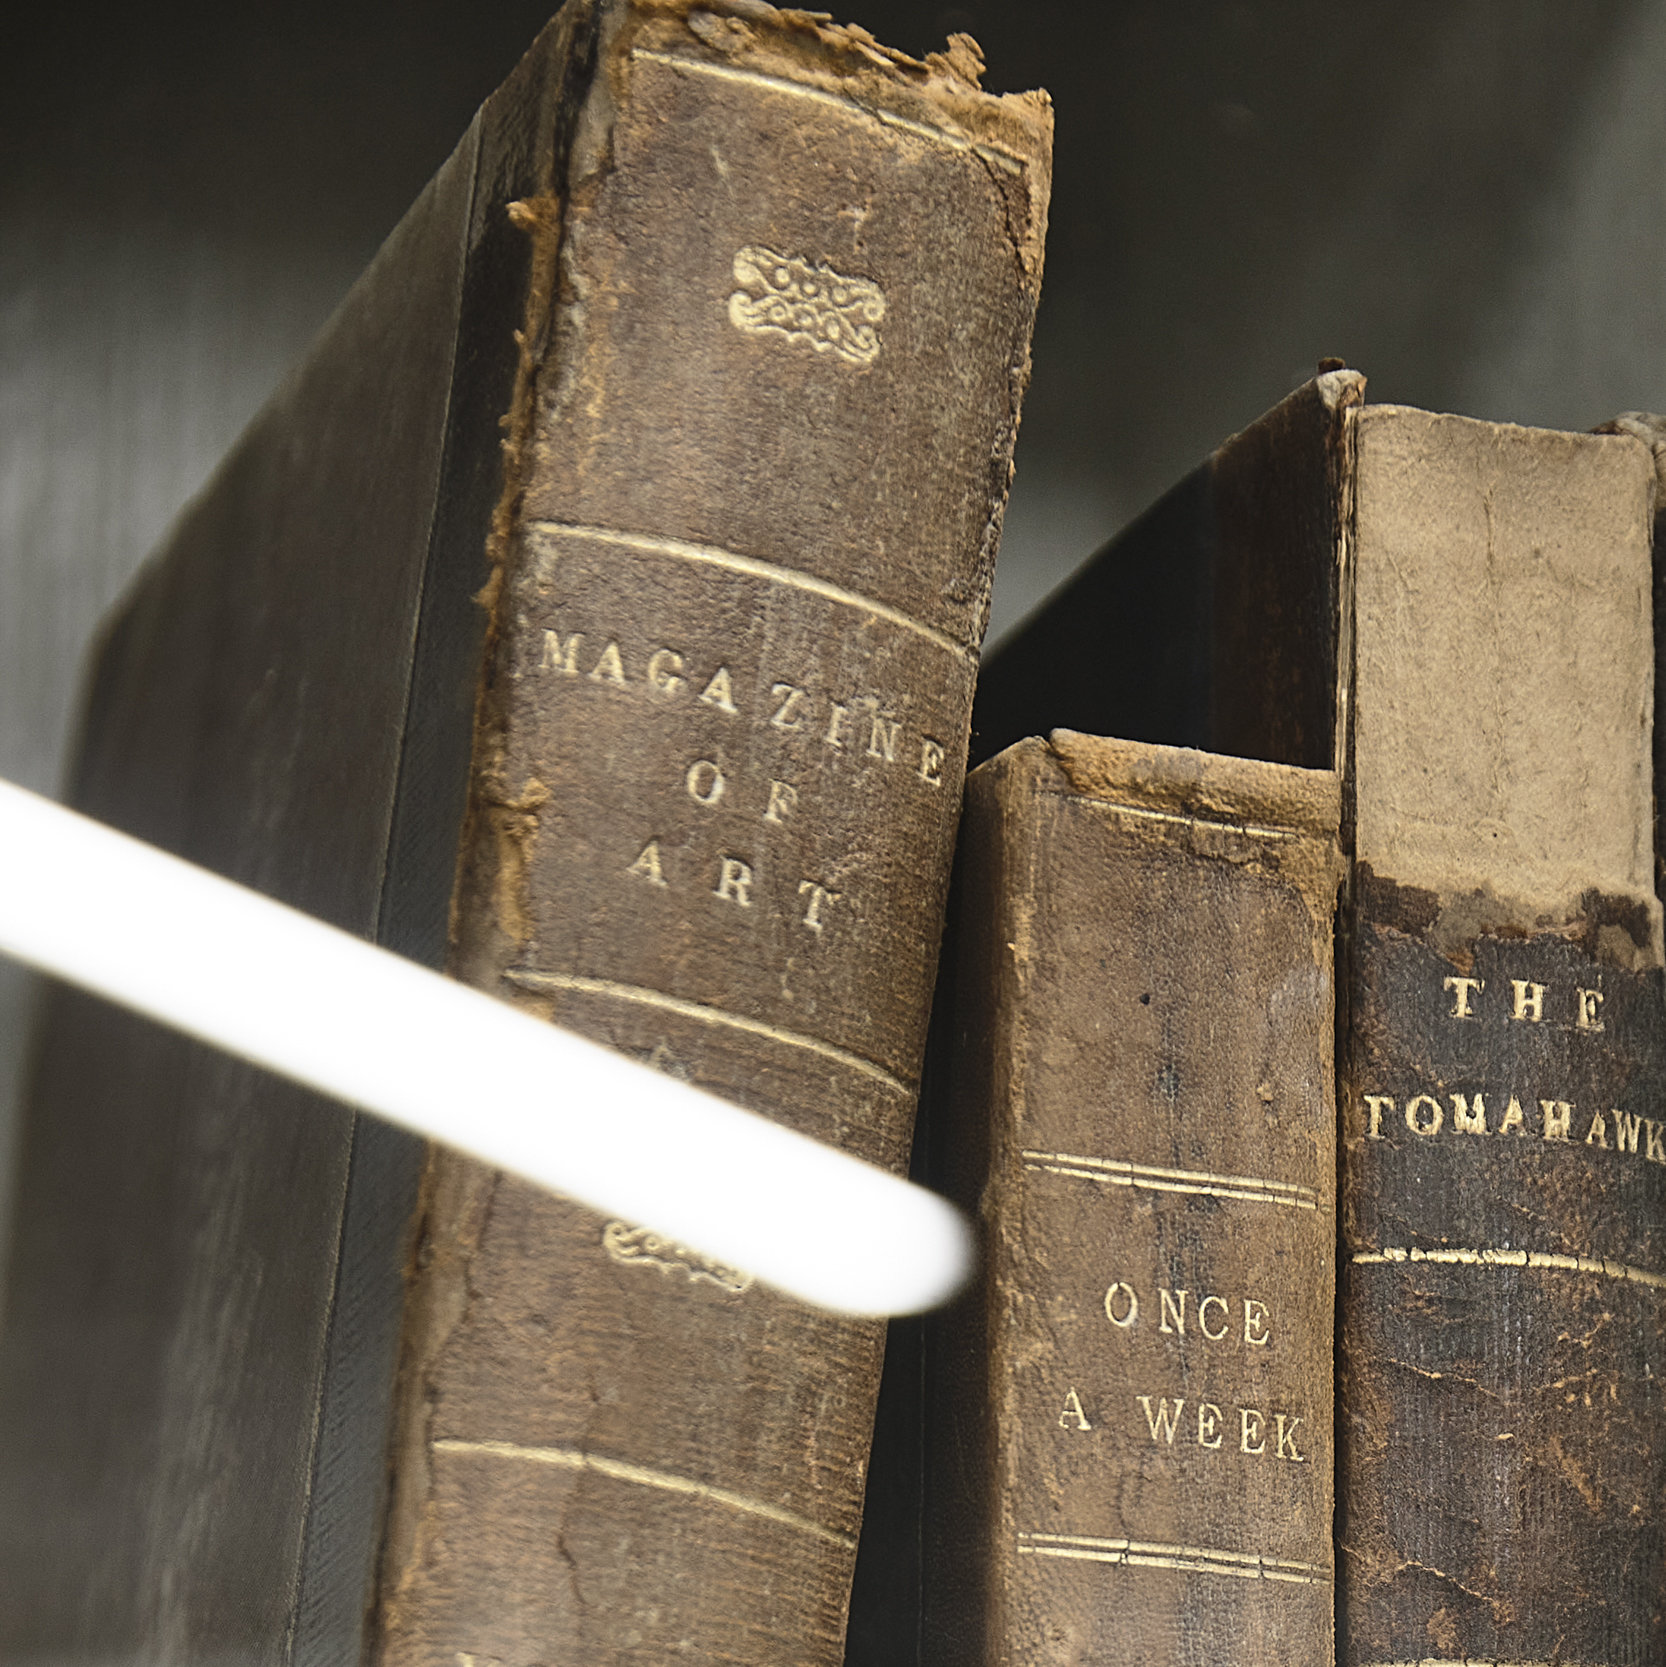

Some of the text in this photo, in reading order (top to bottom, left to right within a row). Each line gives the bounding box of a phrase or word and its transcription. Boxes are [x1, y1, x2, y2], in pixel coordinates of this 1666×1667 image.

[538, 628, 945, 788] MAGAZINE
[686, 760, 800, 824] OF
[626, 834, 842, 932] ART
[1444, 975, 1606, 1032] THE
[1364, 1093, 1666, 1166] TOMAHAWK
[1104, 1281, 1270, 1345] ONCE
[1058, 1386, 1304, 1462] A WEEK
